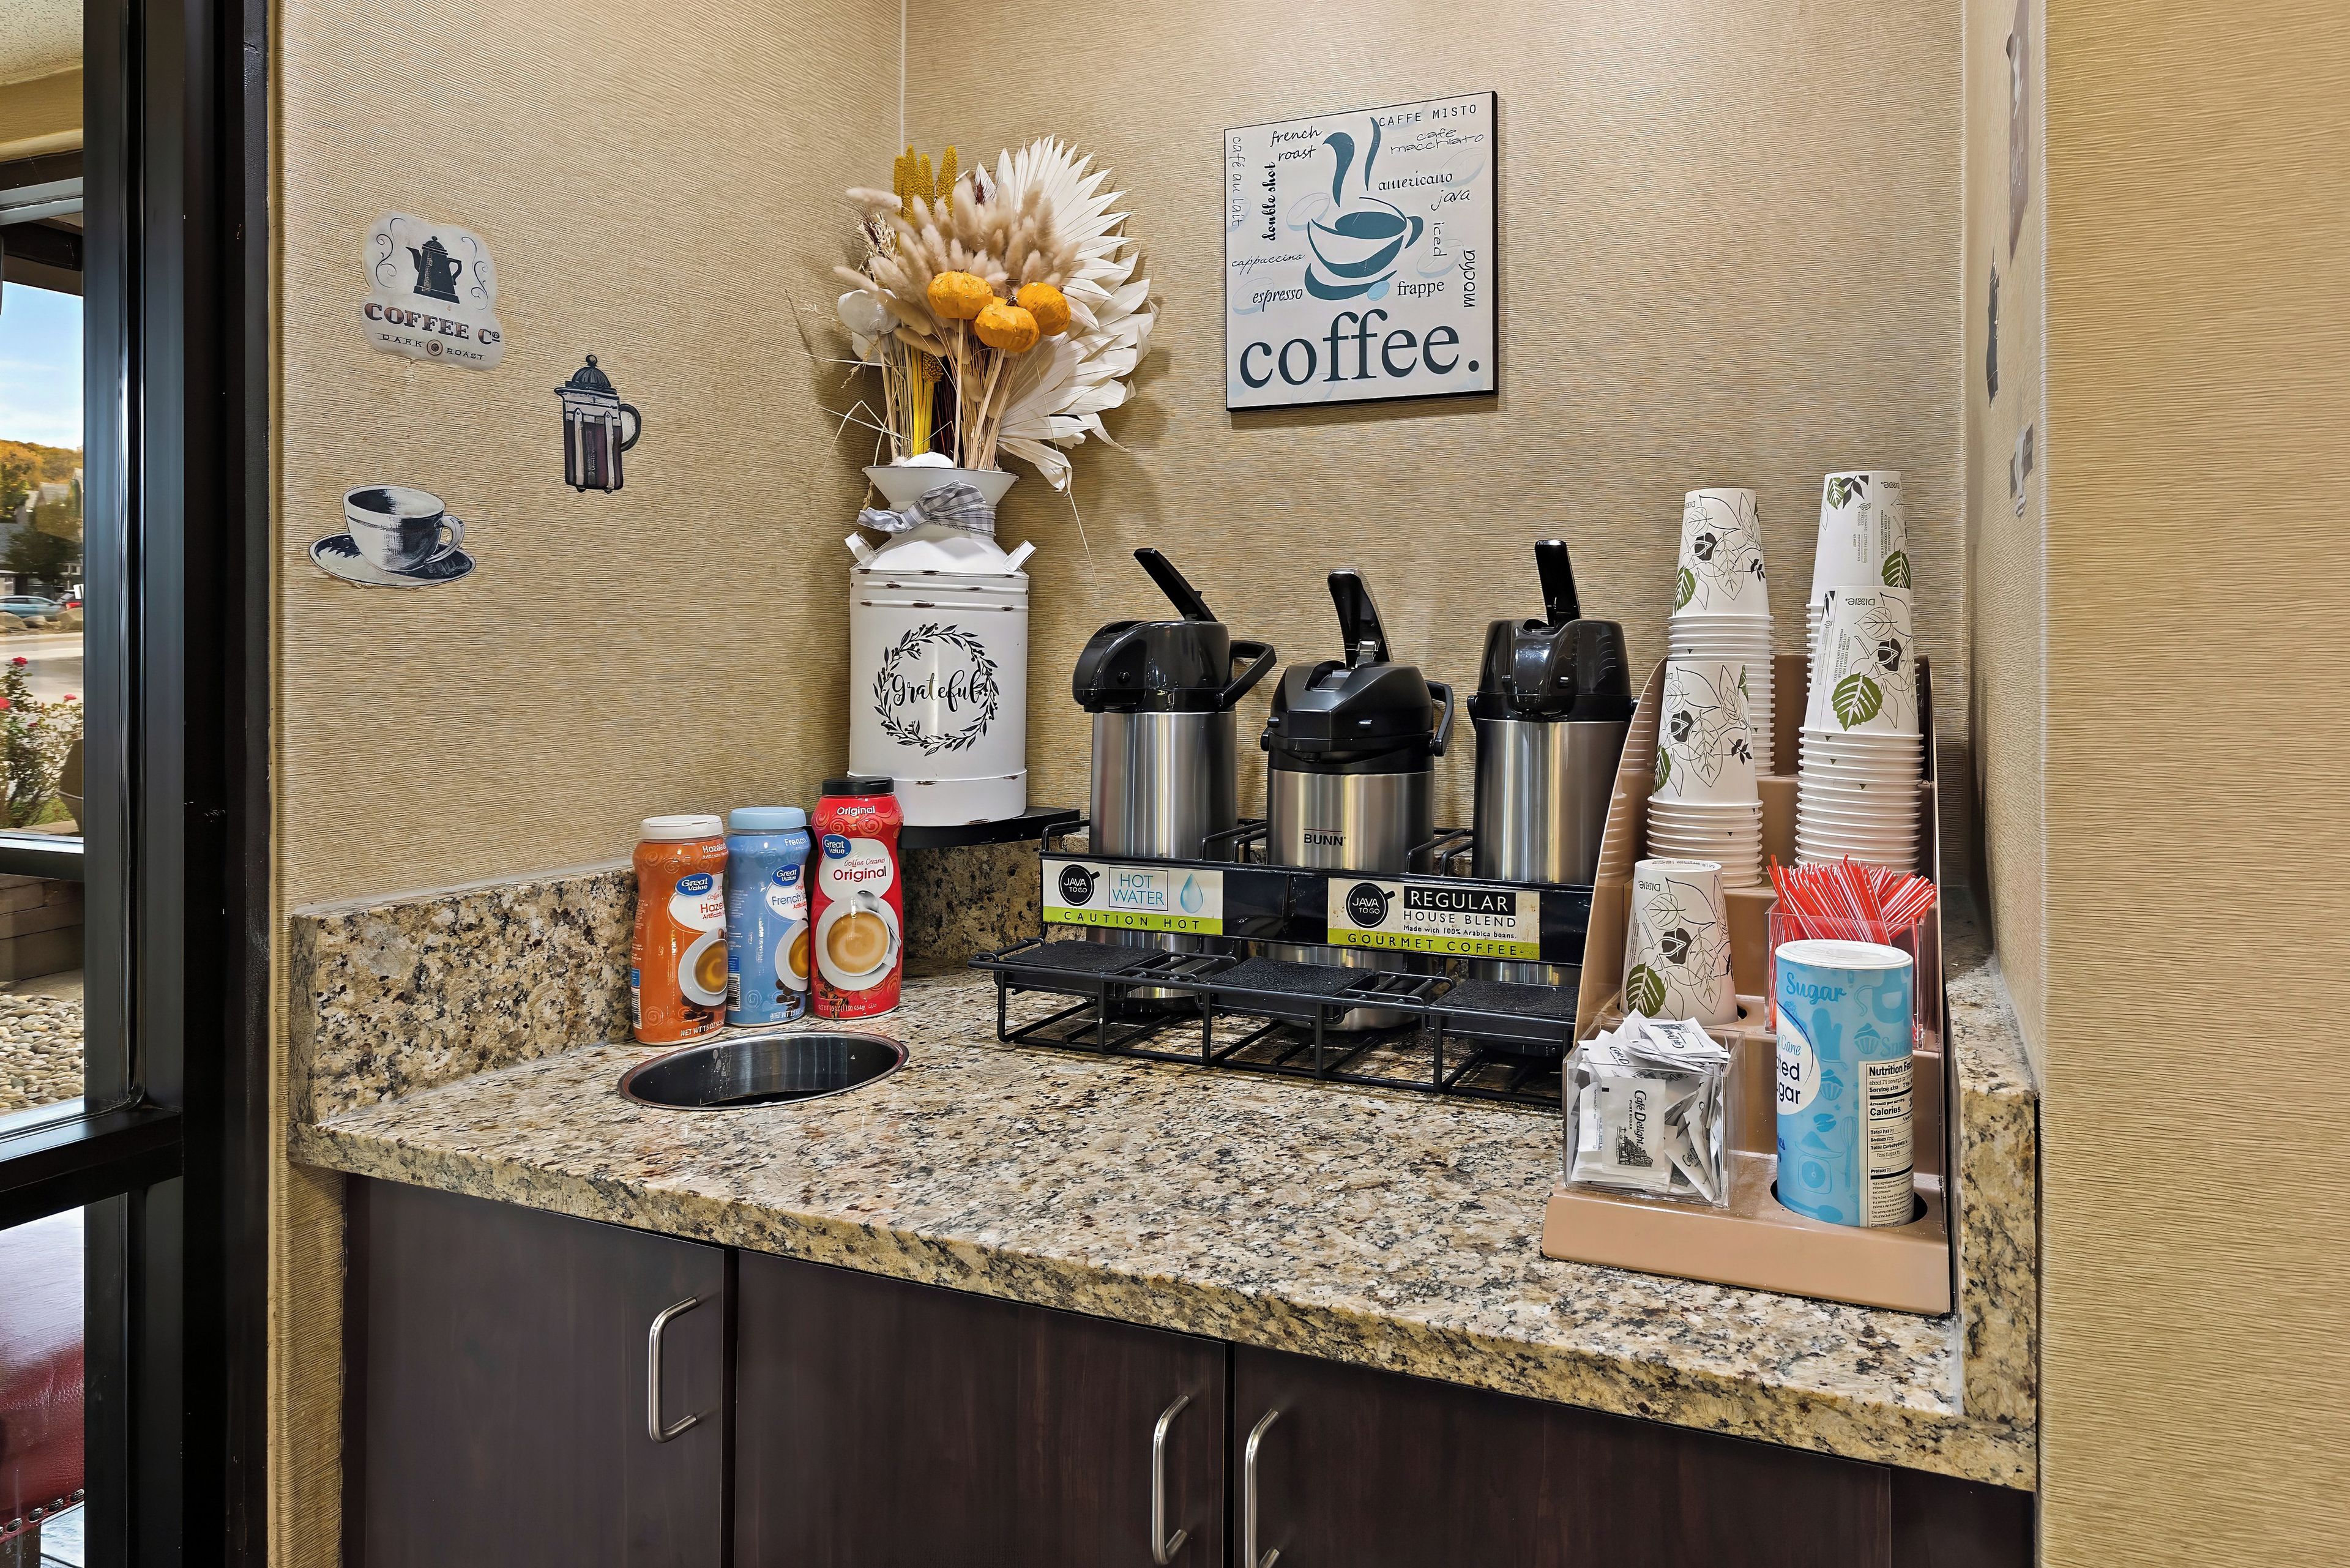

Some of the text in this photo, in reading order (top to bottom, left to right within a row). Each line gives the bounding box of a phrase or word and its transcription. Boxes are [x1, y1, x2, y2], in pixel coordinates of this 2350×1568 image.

[1378, 104, 1477, 127] CAFFE MISTO
[1270, 125, 1324, 147] french
[1278, 147, 1317, 162] roast
[1231, 173, 1244, 193] au
[1378, 170, 1453, 191] americano
[1261, 161, 1277, 241] double shot
[1431, 189, 1472, 211] java
[1231, 196, 1245, 228] lait
[1433, 222, 1448, 258] iced
[1231, 253, 1306, 275] cappuccino
[1458, 249, 1476, 308] mocha
[1252, 286, 1304, 312] espresso
[1397, 280, 1445, 298] frappe
[364, 302, 469, 340] COFFEE
[382, 334, 486, 361] DARK ROAST
[1239, 308, 1480, 389] coffee.
[837, 805, 876, 816] Original
[824, 839, 845, 848] Great
[1304, 833, 1343, 846] BUNN
[681, 877, 708, 888] Great
[834, 865, 887, 883] Original
[1064, 878, 1087, 887] JAVA
[1120, 873, 1154, 888] HOT
[772, 893, 801, 906] French
[1113, 889, 1165, 906] WATER
[1352, 897, 1379, 908] JAVA
[1410, 890, 1509, 912] REGULAR
[1064, 911, 1199, 930] CAUTION HOT
[1403, 910, 1516, 928] HOUSE BLEND
[1463, 928, 1491, 938] Arabica
[1347, 932, 1518, 956] GOURMET COFFEE
[1786, 971, 1847, 1005] Sugar
[1781, 1034, 1802, 1056] Cane
[1869, 1064, 1903, 1077] Nutrition
[1635, 1089, 1647, 1111] Café
[1870, 1105, 1901, 1116] Calories
